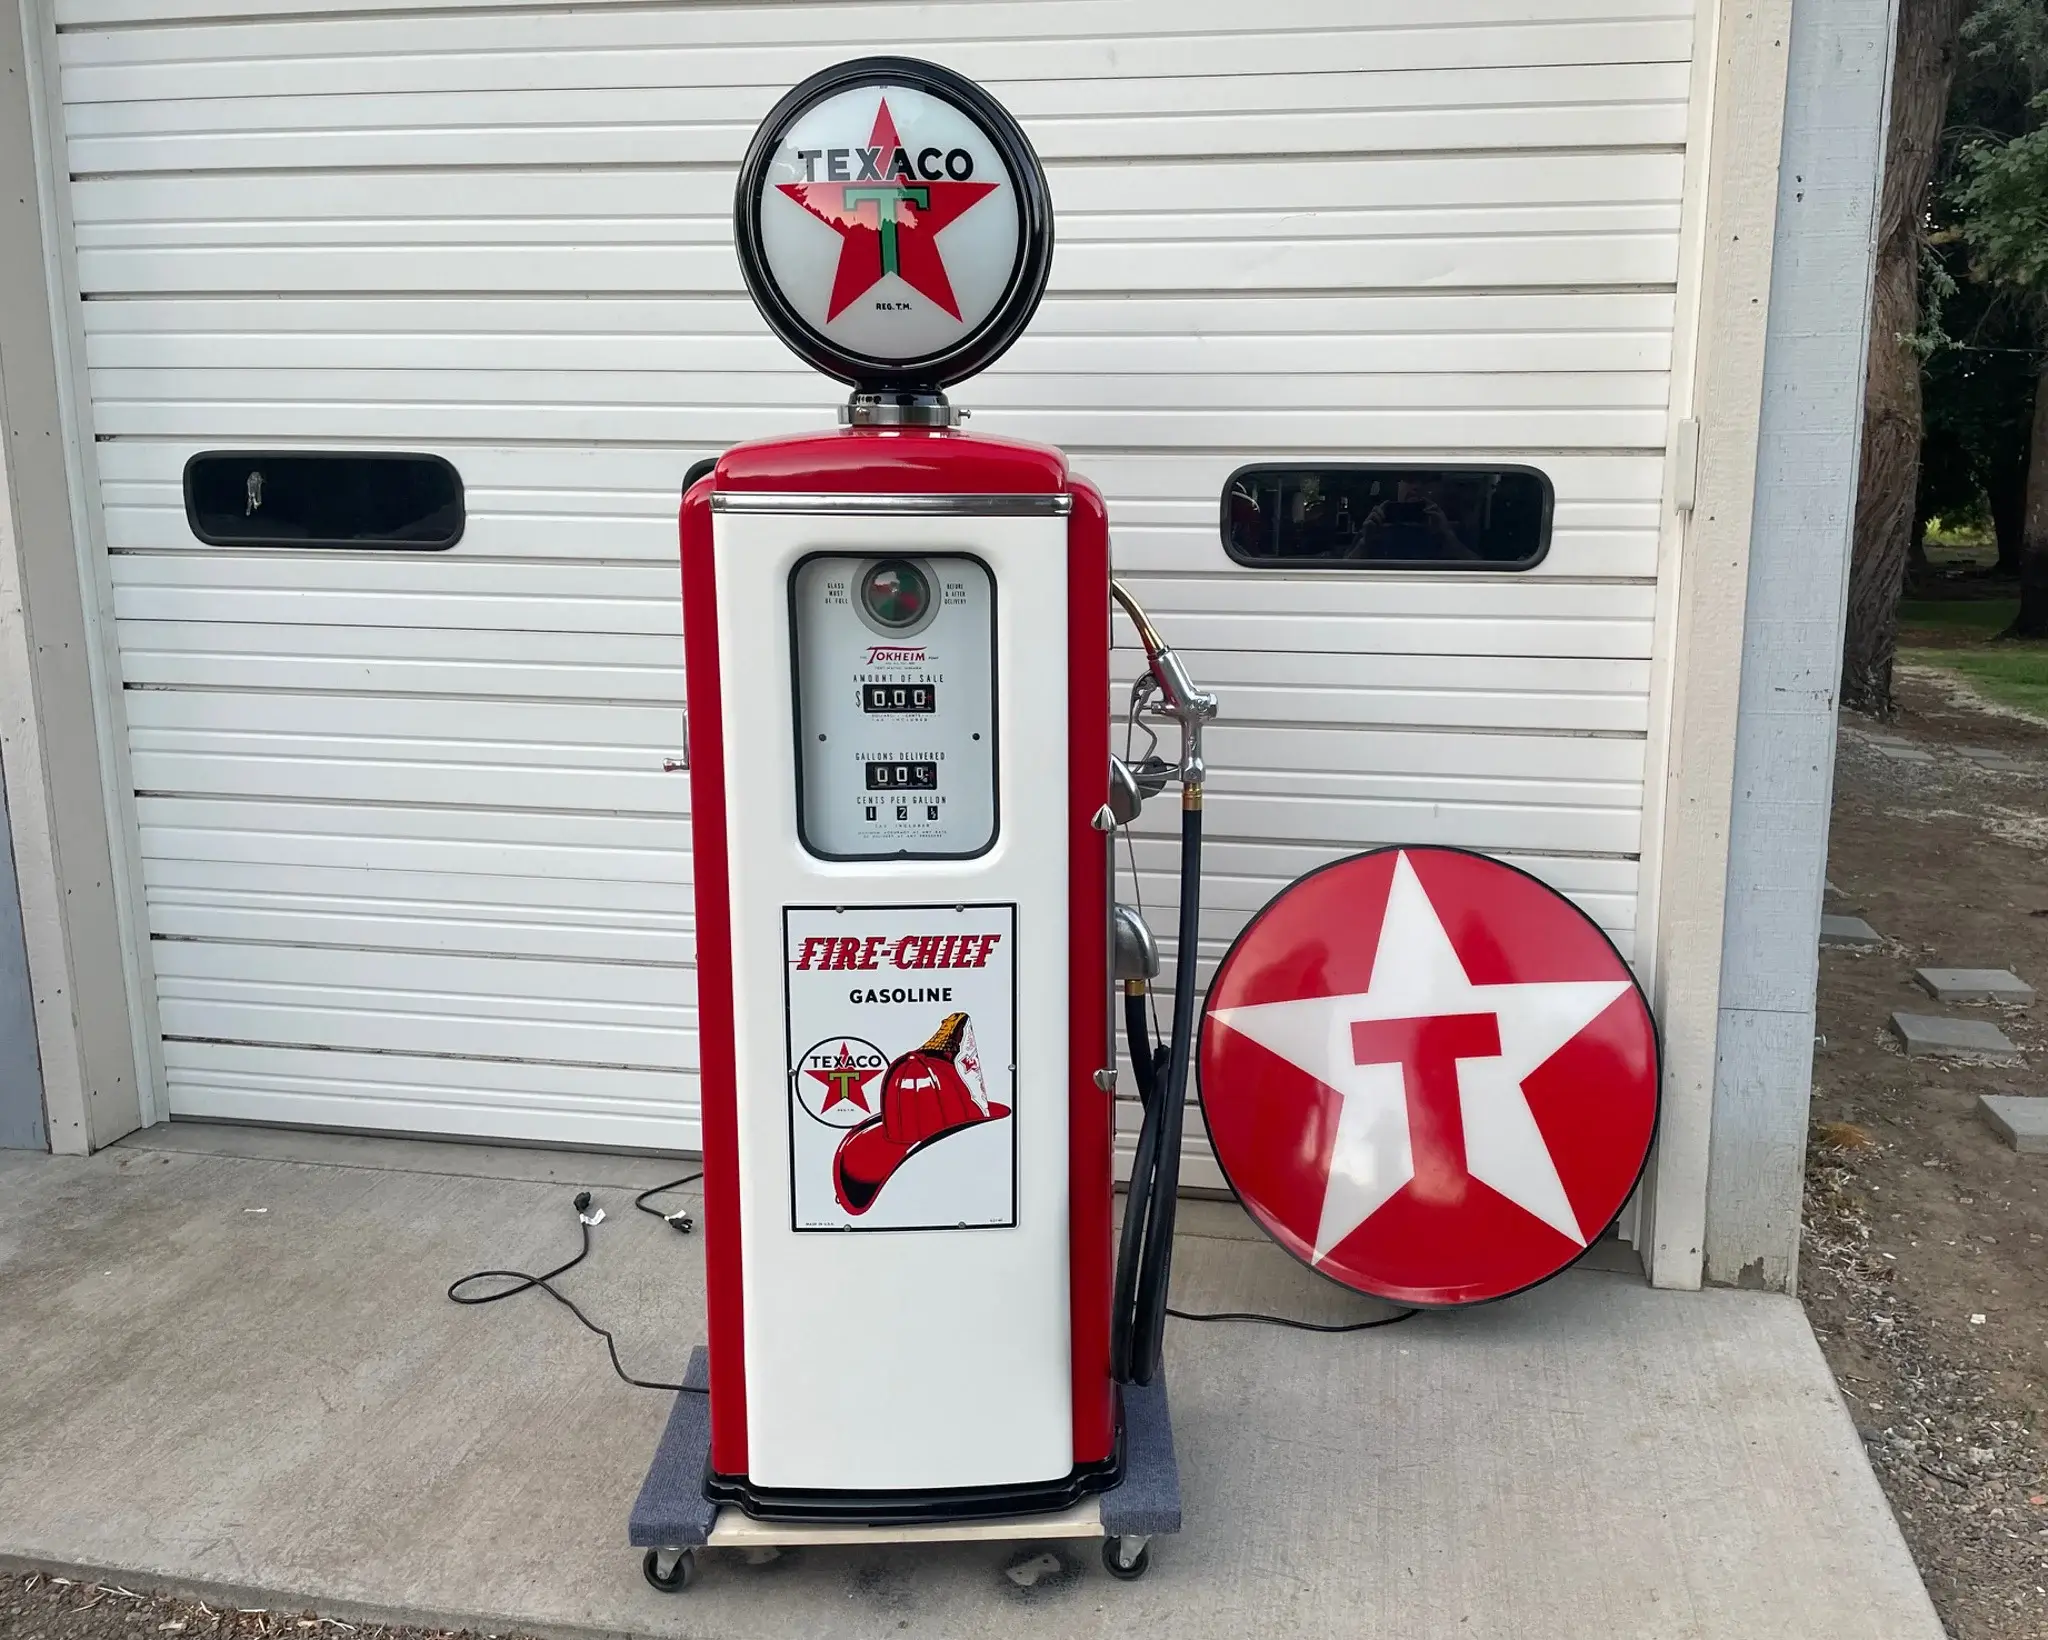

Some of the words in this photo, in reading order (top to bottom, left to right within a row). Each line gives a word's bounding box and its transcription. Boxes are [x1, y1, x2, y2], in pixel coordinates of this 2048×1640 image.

[797, 147, 974, 182] TEXACO
[842, 185, 932, 277] T
[876, 302, 895, 311] REG.
[896, 302, 912, 311] T.M.
[866, 646, 928, 666] TOKHEIM
[853, 674, 893, 682] AMOUNT
[900, 674, 912, 682] OF
[919, 674, 944, 682] SALE
[855, 752, 894, 760] GALLONS
[899, 752, 945, 760] DELIVERED
[856, 797, 885, 805] CENTS
[890, 796, 907, 804] PER
[912, 796, 947, 804] GALLON
[796, 934, 1002, 971] FIRE-CHIEF
[849, 987, 953, 1004] GASOLINE
[809, 1055, 882, 1069] TEXACO
[1349, 1011, 1503, 1180] T
